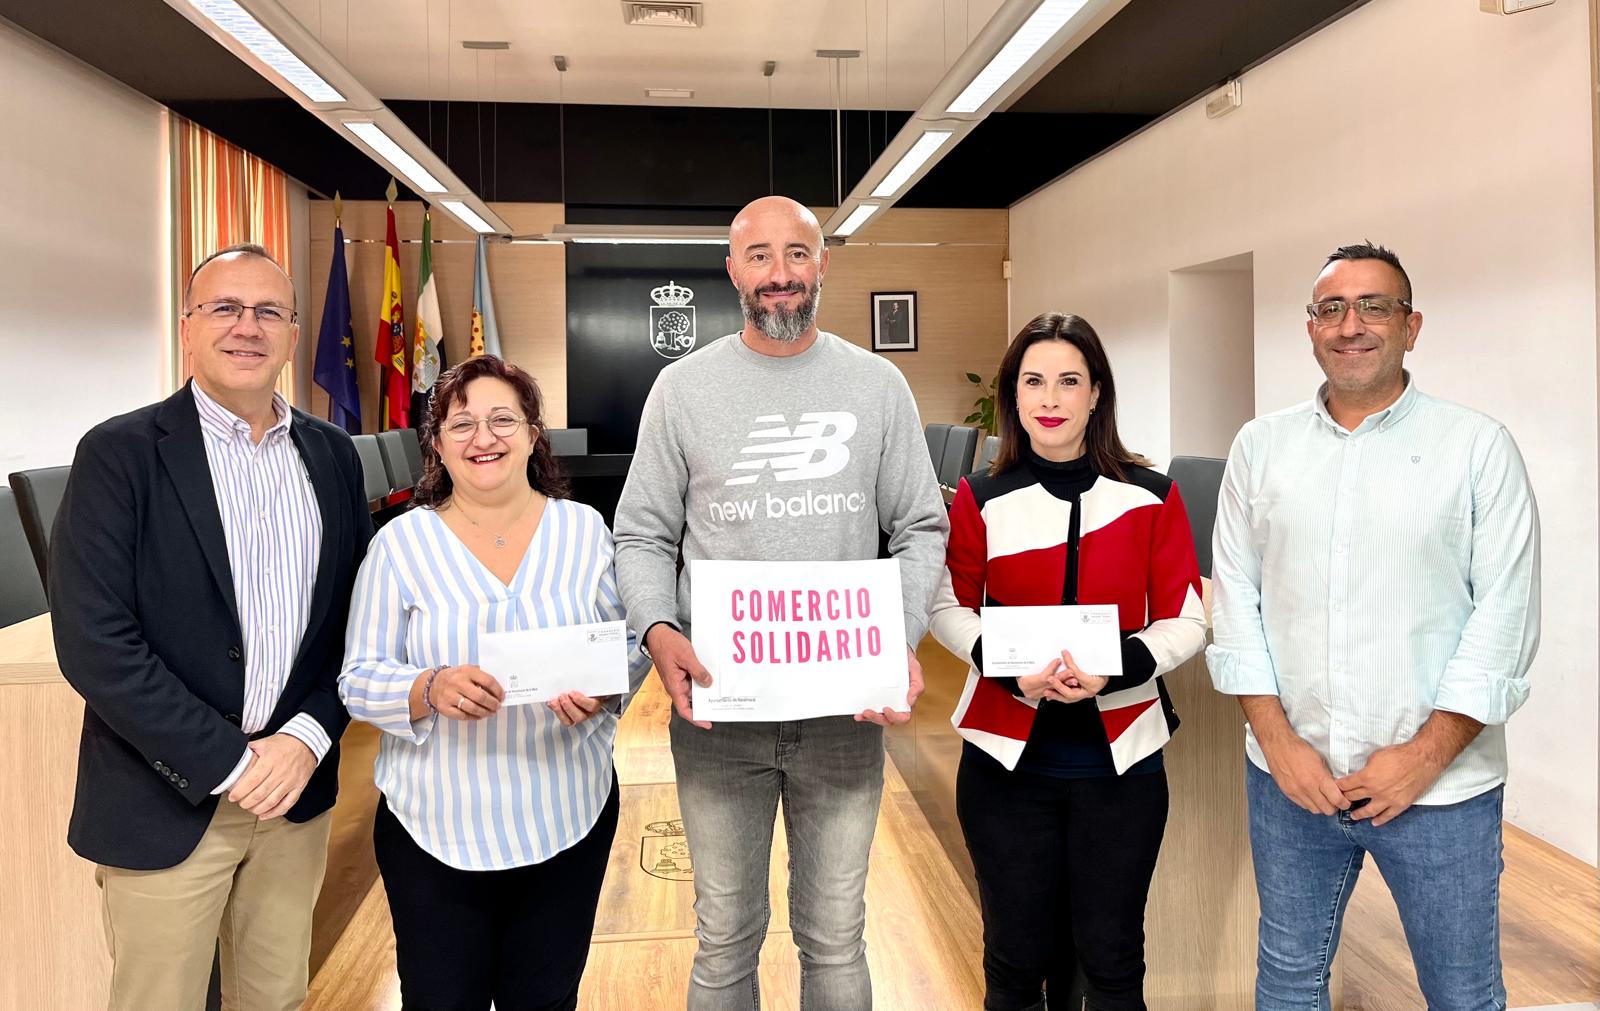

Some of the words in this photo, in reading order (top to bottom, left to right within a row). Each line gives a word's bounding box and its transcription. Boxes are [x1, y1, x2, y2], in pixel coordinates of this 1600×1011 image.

[708, 499, 758, 522] new
[732, 587, 871, 622] COMERCIO
[733, 626, 881, 664] SOLIDARIO
